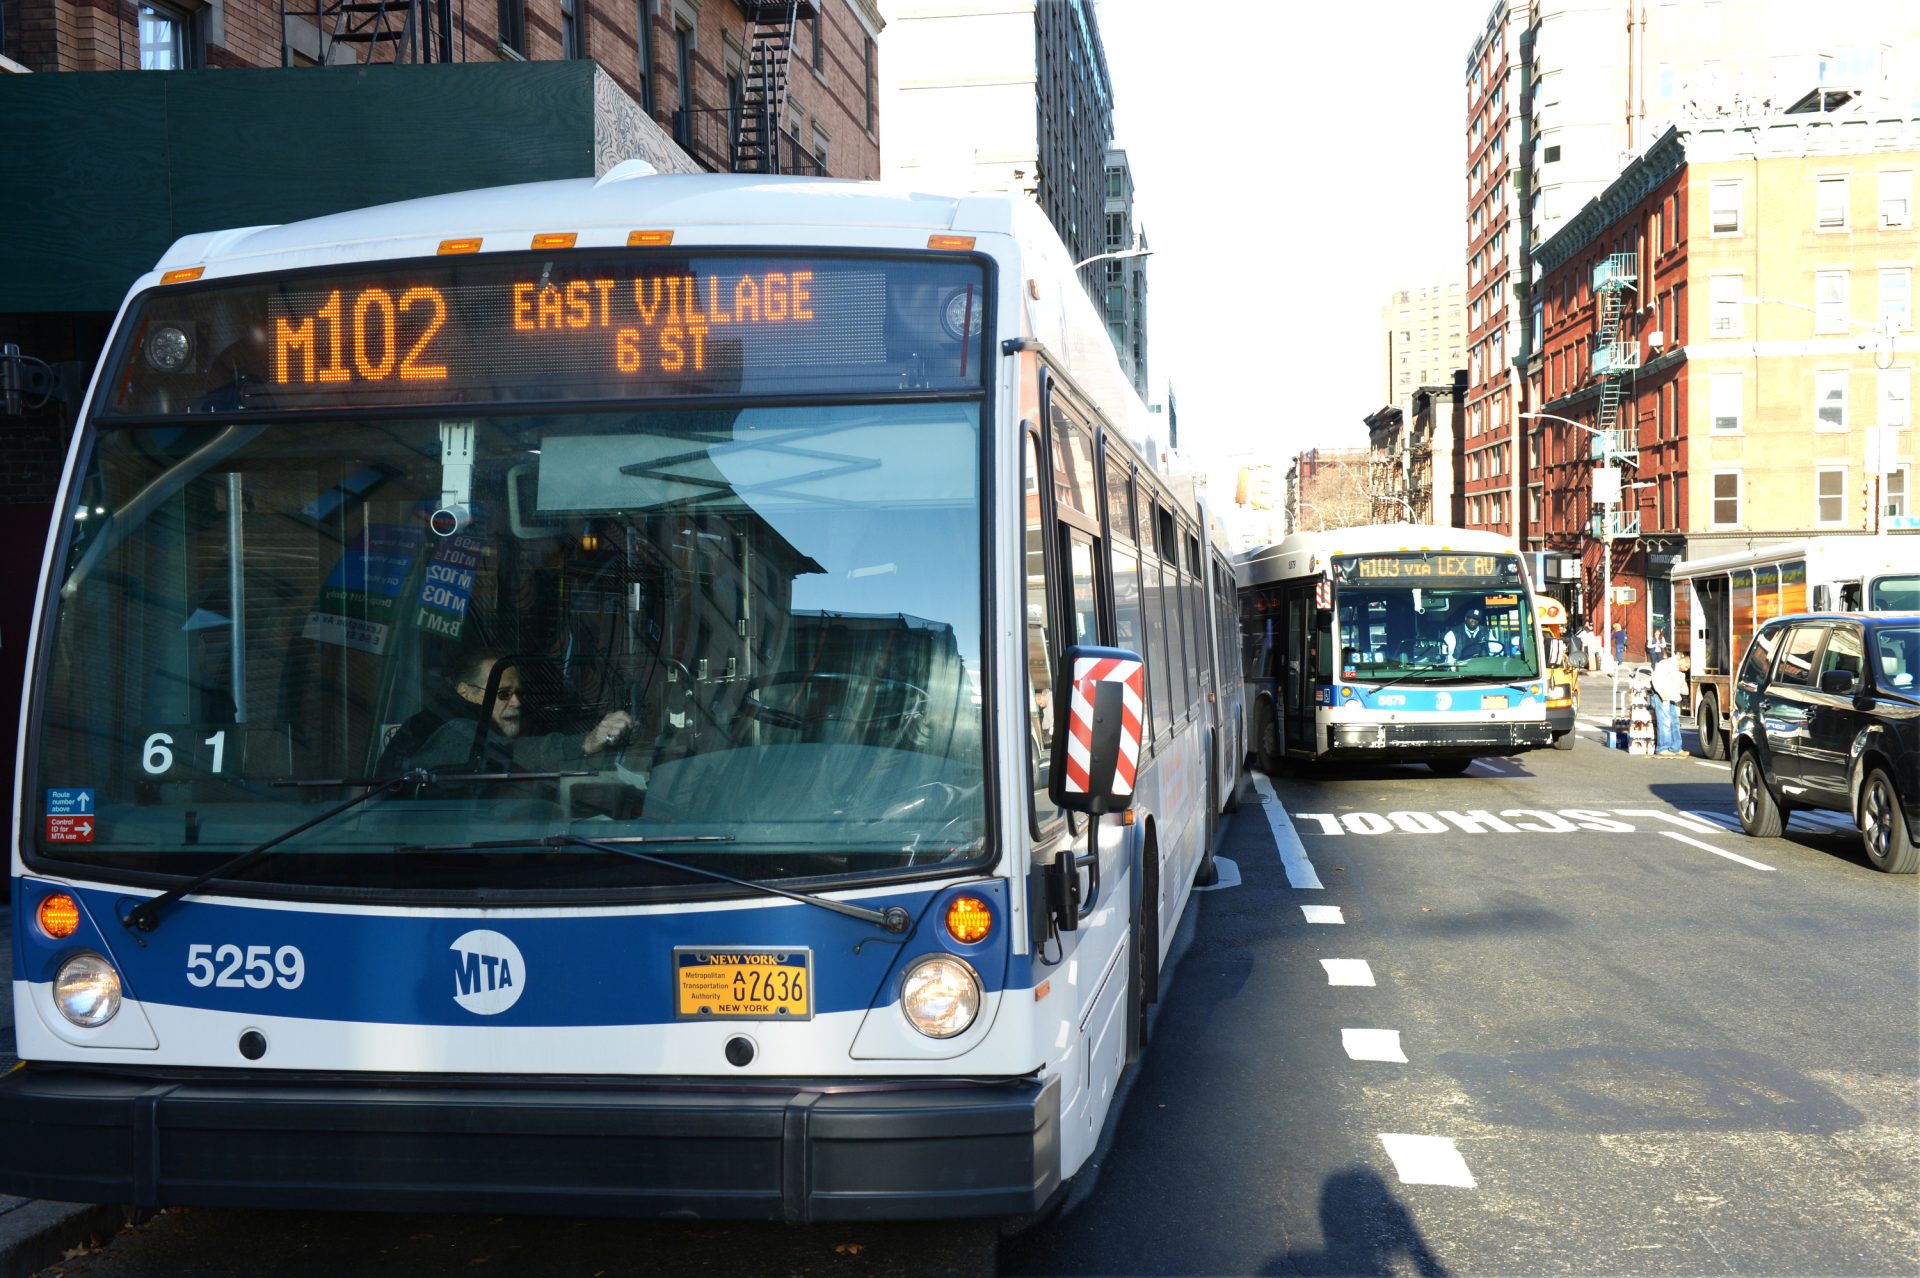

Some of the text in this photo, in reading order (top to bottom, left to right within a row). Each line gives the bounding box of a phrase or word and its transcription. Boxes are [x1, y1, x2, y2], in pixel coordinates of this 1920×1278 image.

[514, 272, 814, 330] EAST VILLAGE
[276, 286, 447, 383] M102
[616, 325, 709, 373] 6 ST
[1359, 557, 1400, 578] M103
[1438, 557, 1469, 576] LEX
[1474, 557, 1495, 576] AV
[142, 731, 226, 775] 6 1
[51, 818, 74, 826] Control
[1295, 808, 1637, 836] SCHOOL
[186, 944, 305, 990] 5259
[452, 947, 514, 999] MTA
[709, 955, 778, 966] NEW YORK
[682, 982, 729, 990] Transportation
[685, 971, 726, 979] Metropolitan
[749, 970, 803, 1002] 2636
[690, 993, 721, 1001] Authority
[718, 1004, 769, 1012] NEW YORK
